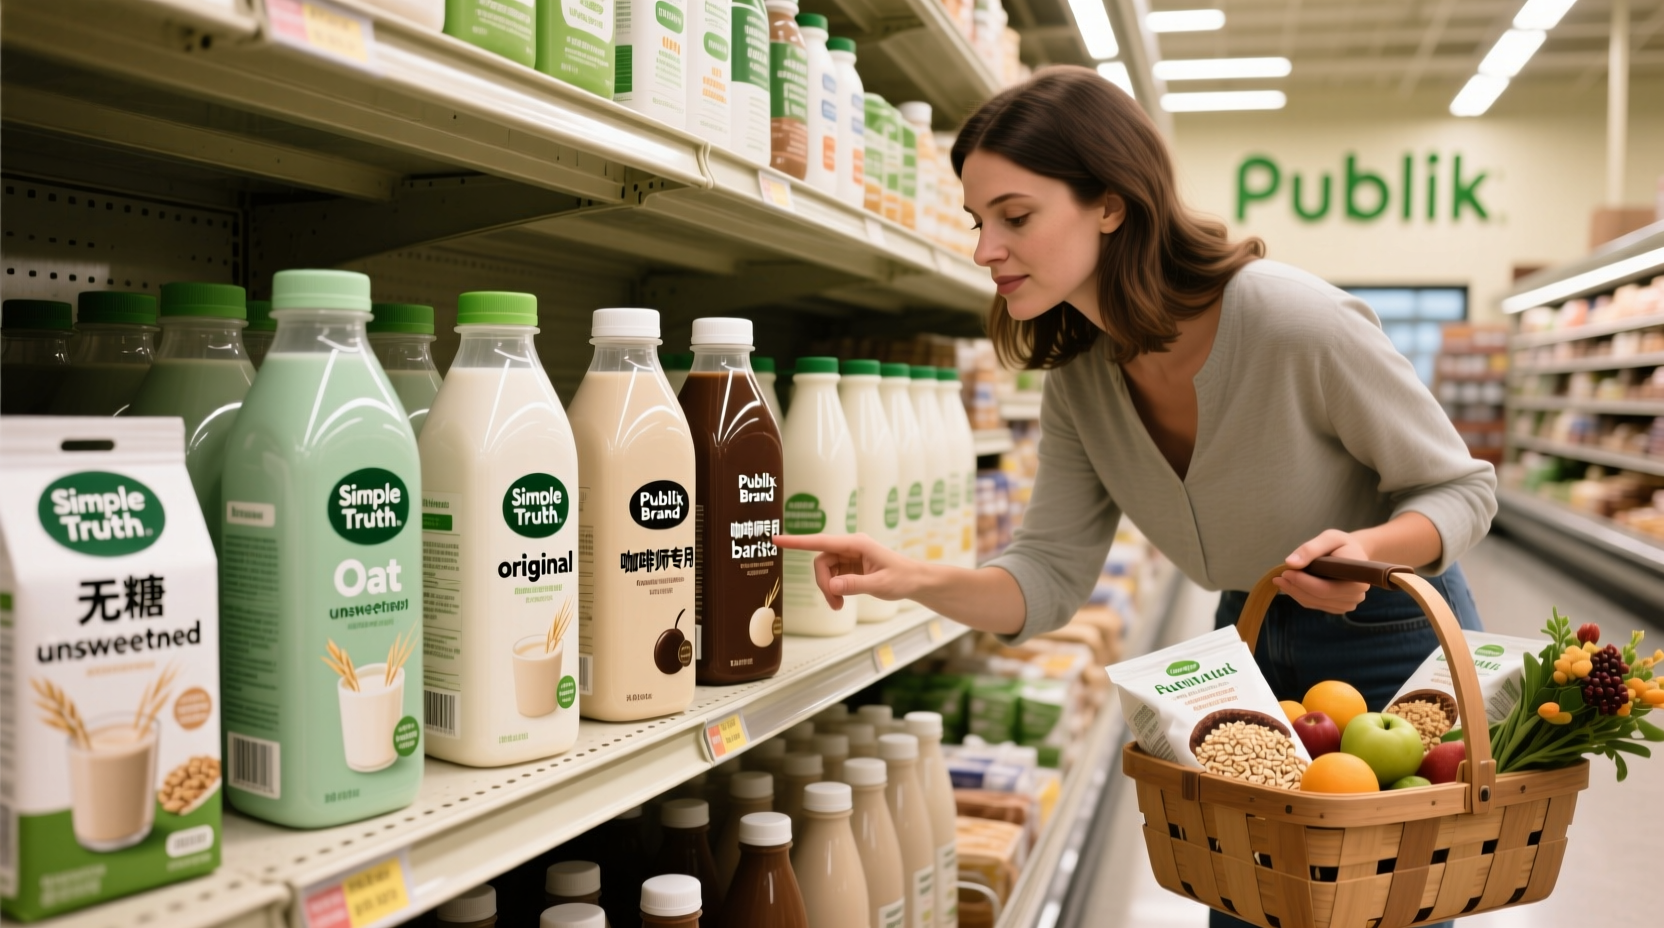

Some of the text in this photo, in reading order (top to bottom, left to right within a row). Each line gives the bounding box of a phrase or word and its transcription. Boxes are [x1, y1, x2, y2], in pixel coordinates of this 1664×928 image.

[1236, 154, 1488, 221] Publik
[51, 485, 146, 518] Simple
[339, 482, 401, 510] Simple
[740, 486, 774, 503] Brand
[641, 505, 681, 521] Brand
[333, 558, 402, 598] Oat
[498, 550, 573, 582] original
[78, 574, 166, 626] 无糖
[37, 619, 201, 664] unsweetned
